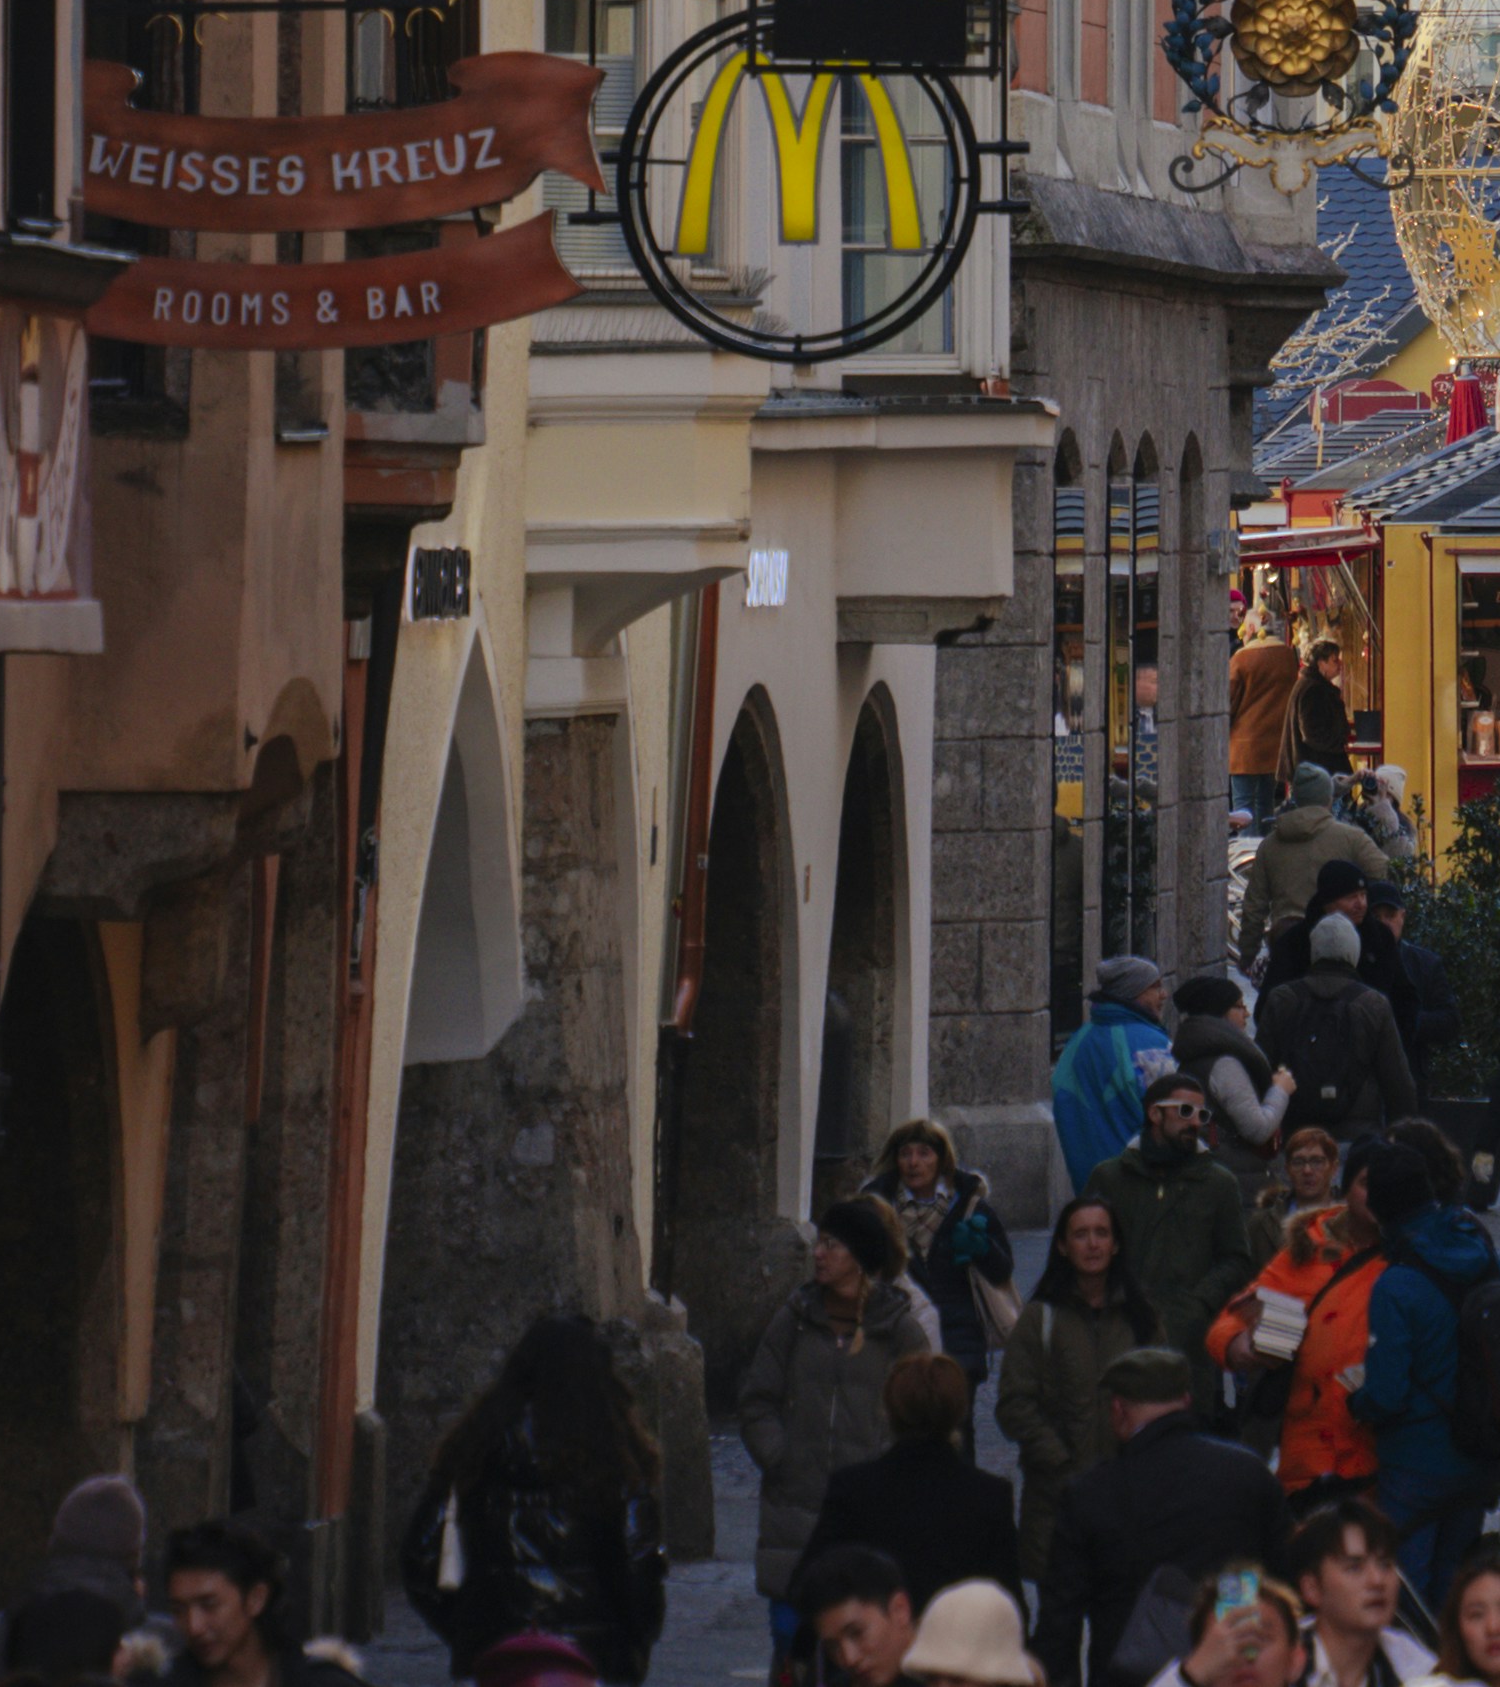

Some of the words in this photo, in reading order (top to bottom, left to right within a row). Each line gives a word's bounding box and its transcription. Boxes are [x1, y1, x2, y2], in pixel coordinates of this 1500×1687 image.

[88, 133, 306, 196] WEISSES
[330, 127, 502, 192] KREUZ
[153, 286, 291, 326] ROOMS
[315, 289, 338, 324] &
[366, 281, 443, 321] BAR
